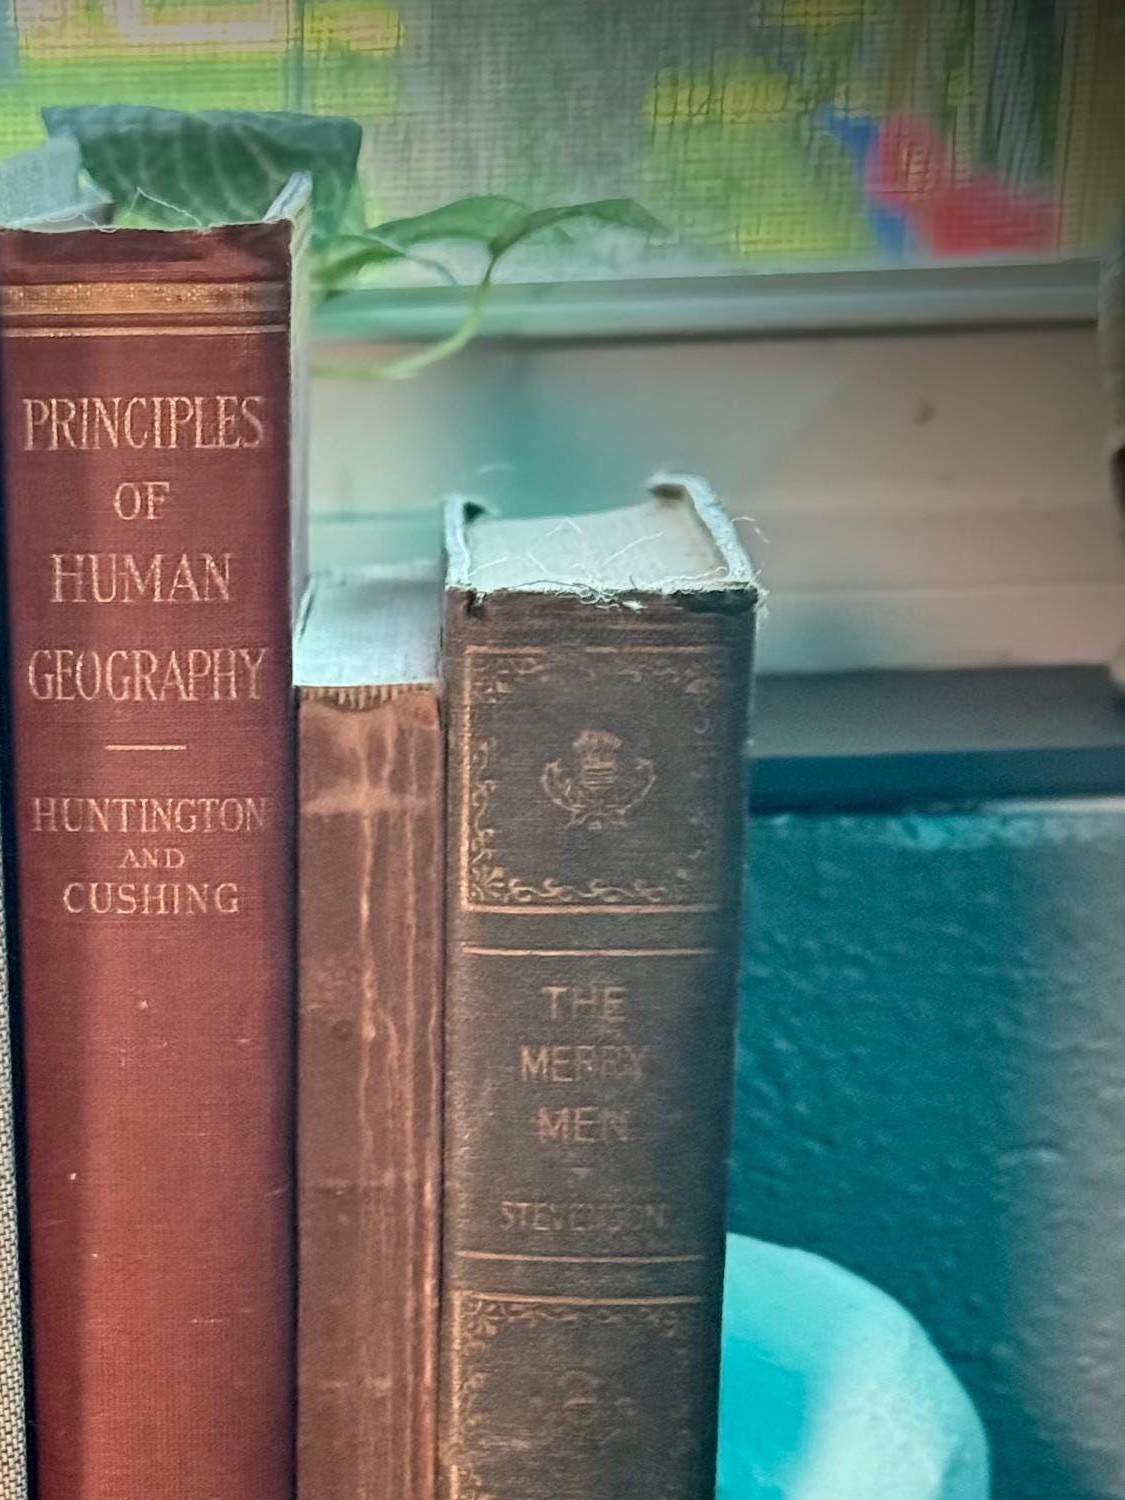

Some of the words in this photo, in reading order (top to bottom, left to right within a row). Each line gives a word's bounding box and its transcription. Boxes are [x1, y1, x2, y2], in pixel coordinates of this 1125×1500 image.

[23, 396, 264, 450] PRINCIPLES
[113, 481, 170, 520] OF
[50, 553, 233, 603] HUMAN
[28, 648, 269, 701] GEOGRAPHY
[30, 797, 267, 833] HUNTINGTON
[119, 848, 186, 869] AND
[62, 882, 240, 915] CUSHING
[540, 985, 627, 1022] THE
[537, 1105, 629, 1143] MEN
